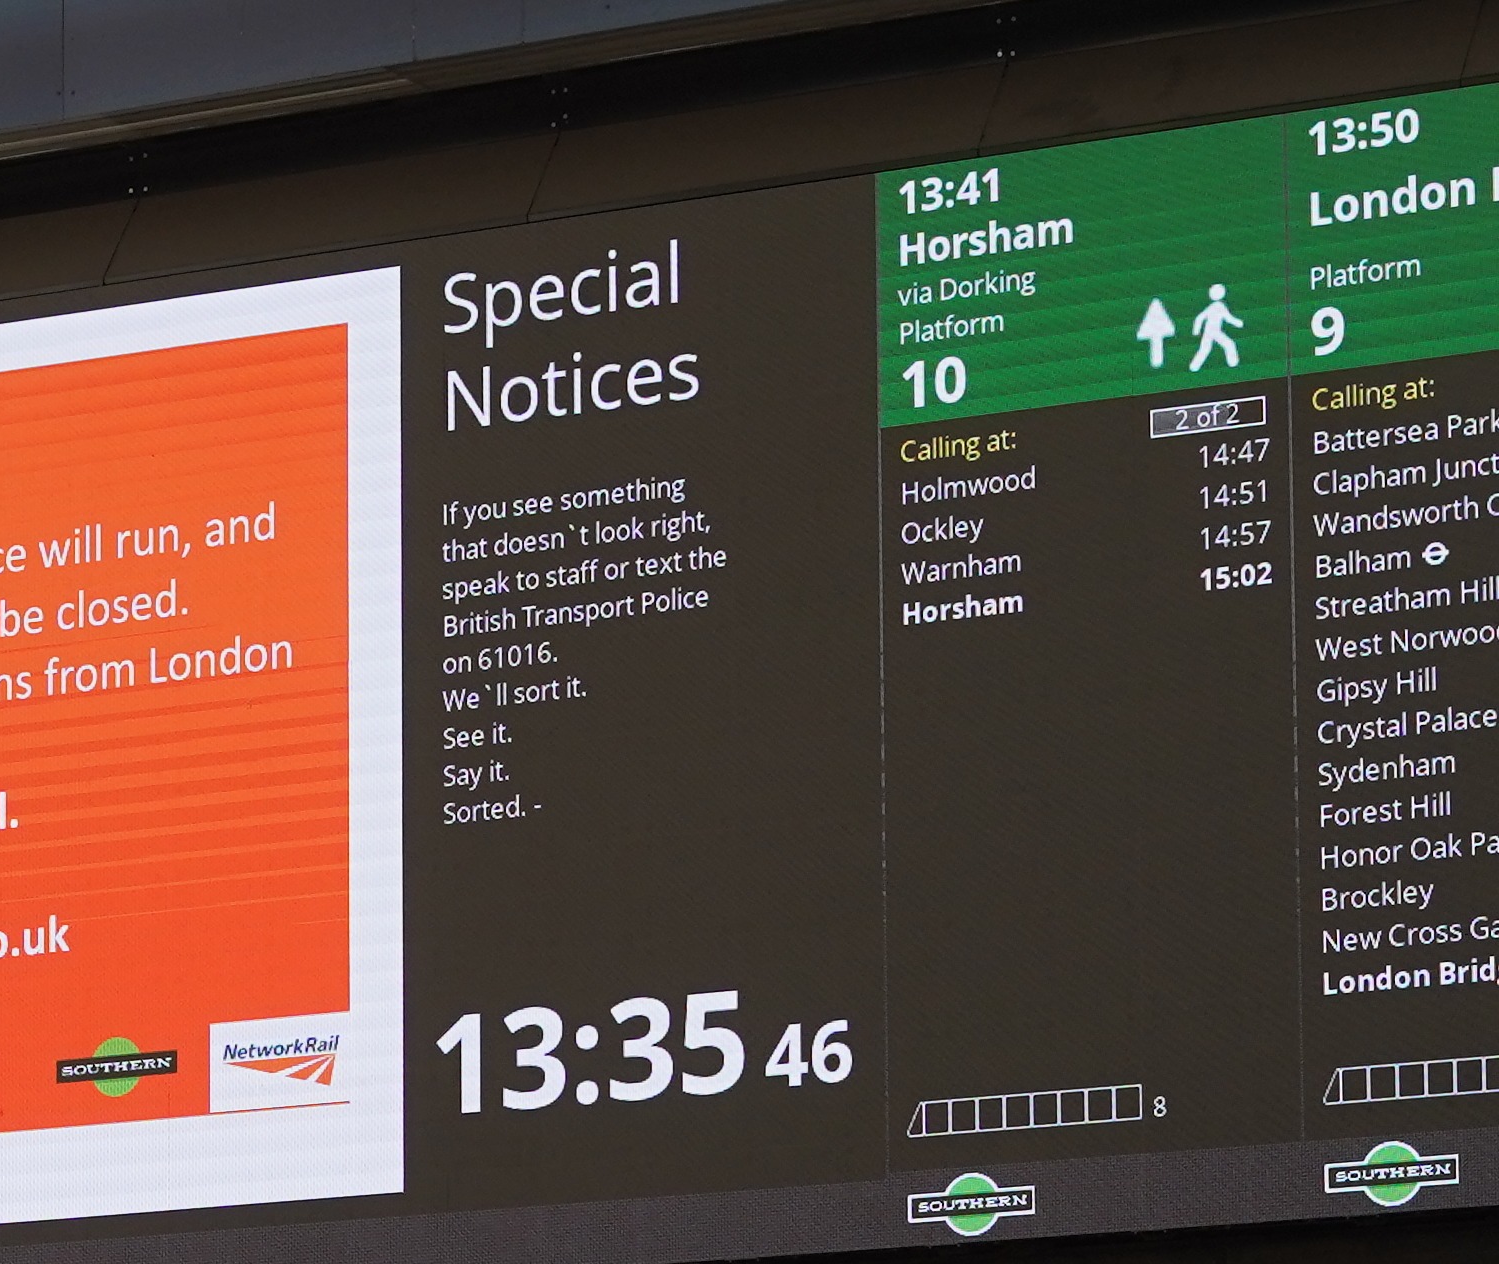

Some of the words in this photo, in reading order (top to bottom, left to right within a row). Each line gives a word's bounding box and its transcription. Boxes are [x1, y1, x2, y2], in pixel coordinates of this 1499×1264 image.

[1308, 108, 1420, 156] 13:50
[898, 167, 999, 215] 13:41
[1310, 174, 1476, 227] London
[899, 218, 1074, 267] Horsham
[444, 238, 679, 349] Special
[897, 282, 932, 307] via
[940, 271, 1036, 301] Dorking
[1310, 258, 1421, 290] Platform
[900, 314, 1004, 345] Platform
[1310, 306, 1345, 356] 9
[447, 353, 699, 432] Notices
[902, 356, 967, 408] 10
[1314, 422, 1439, 455] Battersea
[443, 500, 459, 526] If
[462, 501, 506, 530] you
[512, 495, 553, 517] see
[560, 478, 686, 511] something
[902, 464, 1036, 505] Holmwood
[1199, 479, 1266, 510] 14:51
[38, 523, 102, 569] will
[116, 520, 191, 565] run,
[205, 500, 275, 547] and
[901, 515, 984, 545] Ockley
[1316, 549, 1411, 579] Balham
[443, 607, 516, 638] British
[521, 595, 635, 628] Transport
[641, 587, 709, 615] Police
[442, 655, 472, 675] on
[478, 641, 558, 671] 61016.
[1316, 678, 1388, 707] Gipsy
[1396, 666, 1437, 695] Hill
[1317, 711, 1407, 749] Crystal
[1416, 706, 1498, 735] Palace
[443, 764, 483, 791] Say
[489, 761, 510, 782] it.
[1322, 879, 1434, 912] Brockley
[61, 1057, 172, 1077] SOUTHERN
[223, 1036, 339, 1061] NetworkRail
[436, 990, 745, 1114] 13:35
[765, 1019, 853, 1087] 46
[917, 1192, 1028, 1214] SOUTHERN
